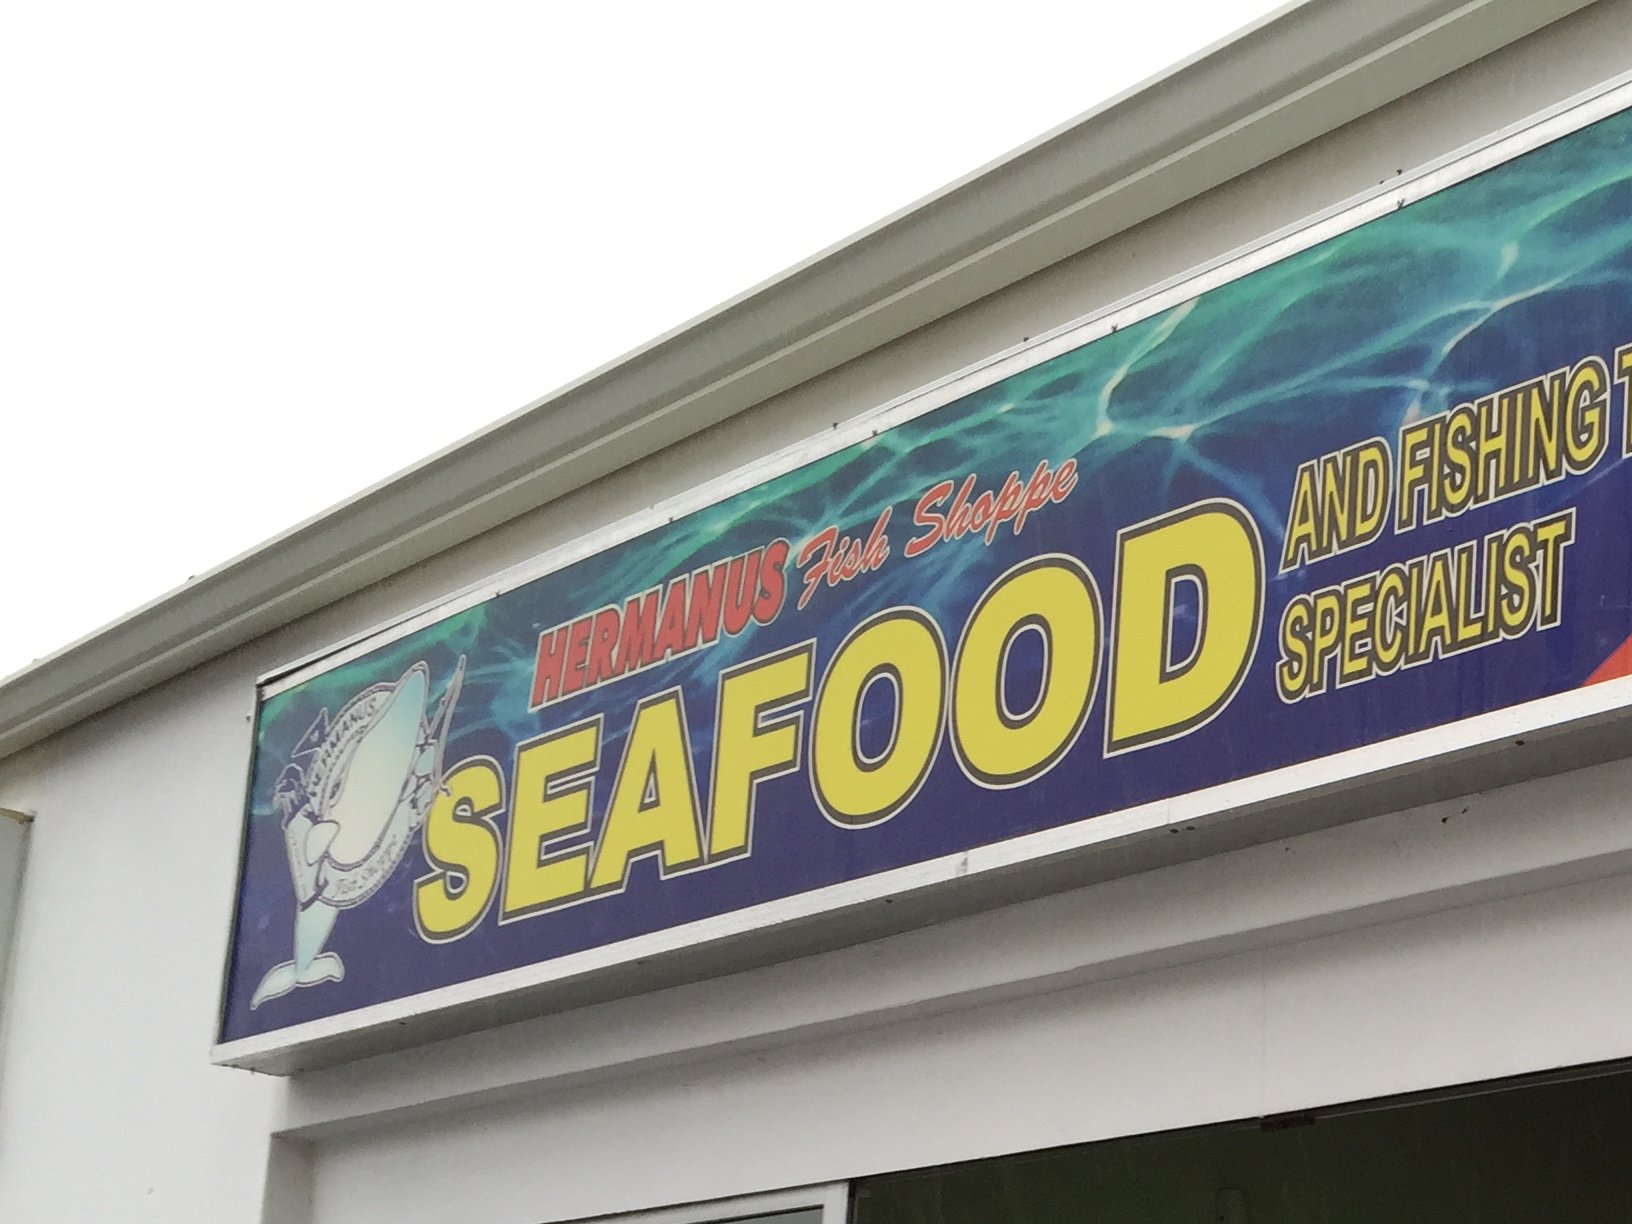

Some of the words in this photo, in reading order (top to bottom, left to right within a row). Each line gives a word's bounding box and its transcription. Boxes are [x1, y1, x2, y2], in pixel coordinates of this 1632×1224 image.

[1281, 437, 1390, 570] AND
[1395, 356, 1609, 533] FISHING
[530, 538, 790, 712] HERMANUS
[797, 509, 889, 610] Fish
[904, 458, 1079, 558] Shoppe
[1276, 507, 1575, 703] SPECIALIST
[412, 497, 1266, 945] SEAFOOD
